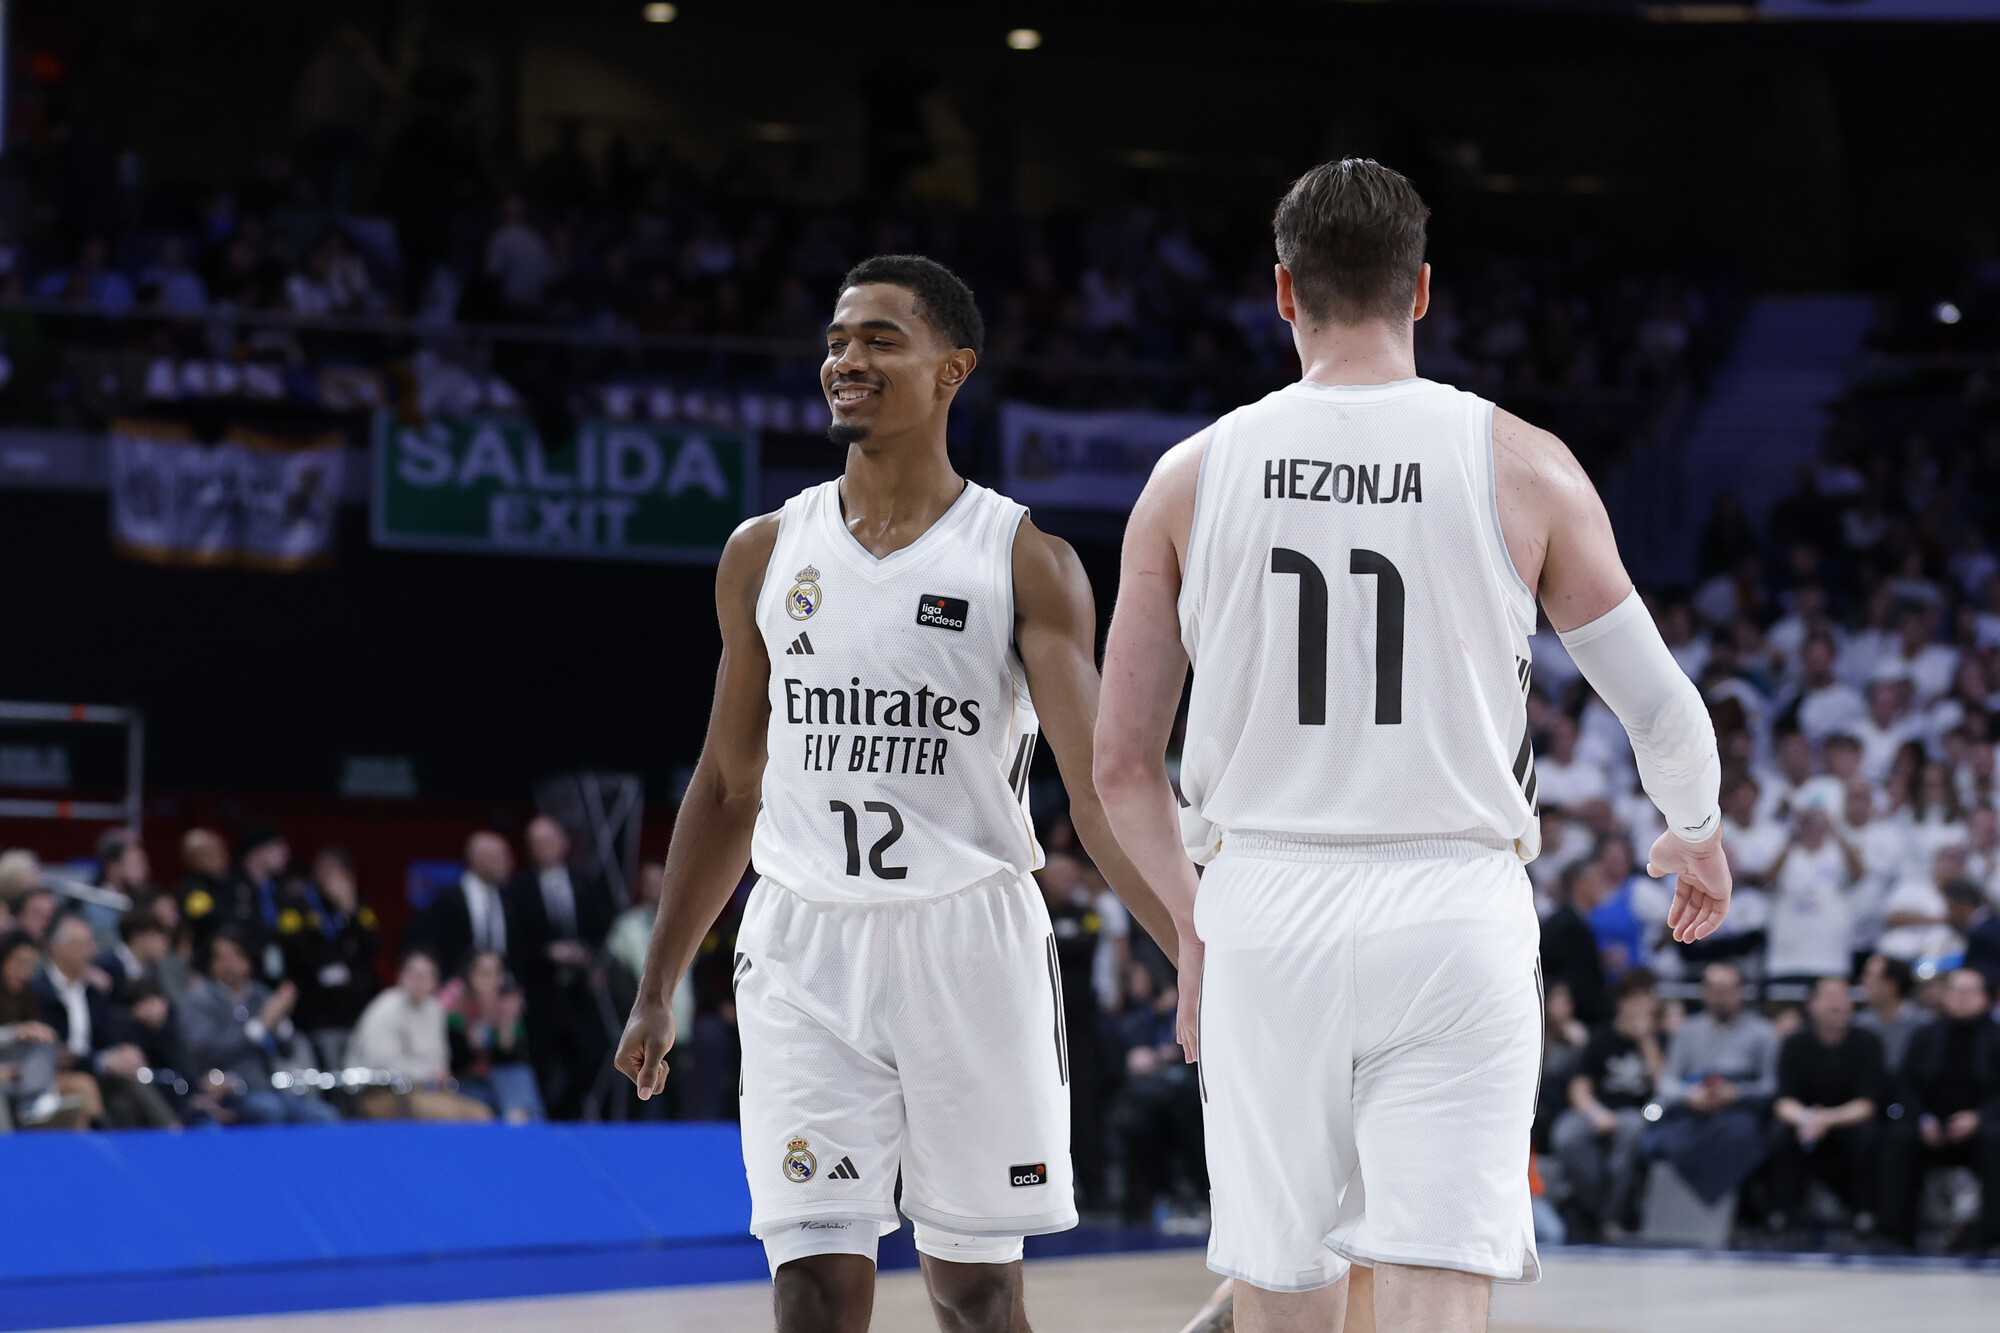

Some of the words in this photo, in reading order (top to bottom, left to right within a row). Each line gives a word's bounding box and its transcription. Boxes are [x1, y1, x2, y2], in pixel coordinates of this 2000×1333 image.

[401, 423, 728, 498] SALIDA
[1264, 459, 1422, 504] HEZONJA
[489, 495, 639, 549] EXIT
[920, 614, 963, 628] endesa
[921, 603, 942, 615] liga
[1271, 547, 1405, 725] 11
[784, 676, 980, 736] Emirates
[804, 735, 841, 771] FLY
[848, 735, 948, 775] BETTER
[829, 800, 908, 879] 12
[1013, 1172, 1040, 1185] acb
